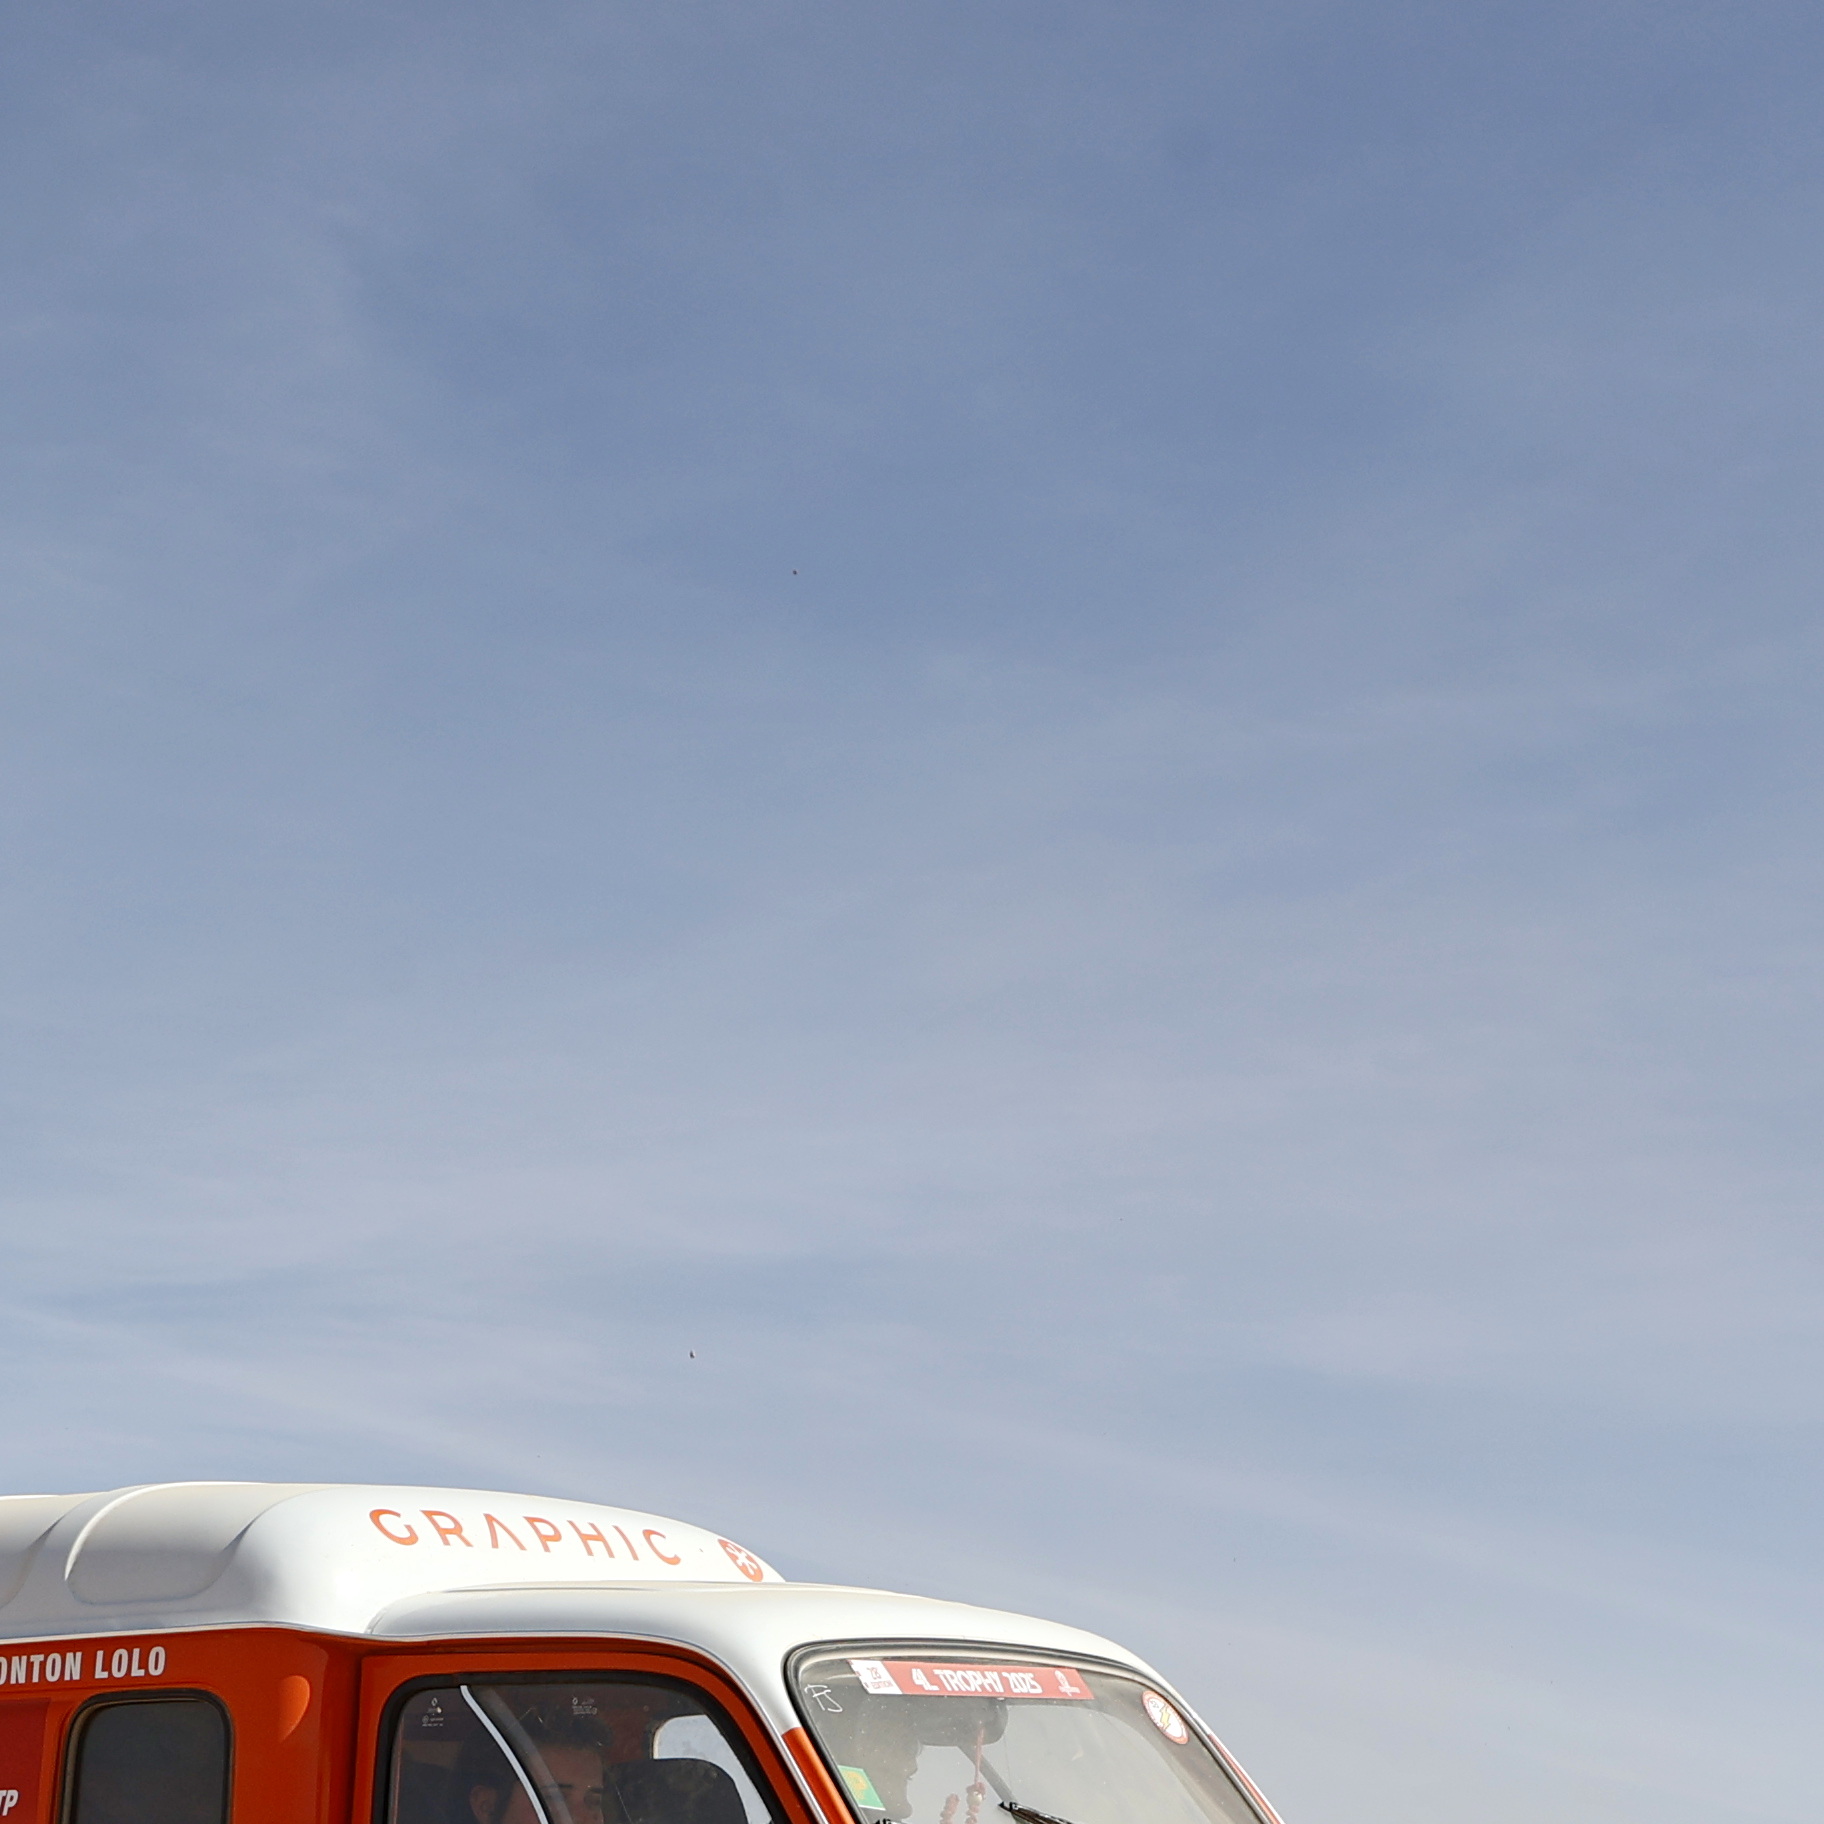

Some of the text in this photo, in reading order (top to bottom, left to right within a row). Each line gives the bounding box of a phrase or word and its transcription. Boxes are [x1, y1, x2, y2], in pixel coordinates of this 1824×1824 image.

[369, 1508, 681, 1565] GRAPHIC
[94, 1646, 166, 1679] LOLO
[911, 1668, 1043, 1694] 4L TROPHY 2025
